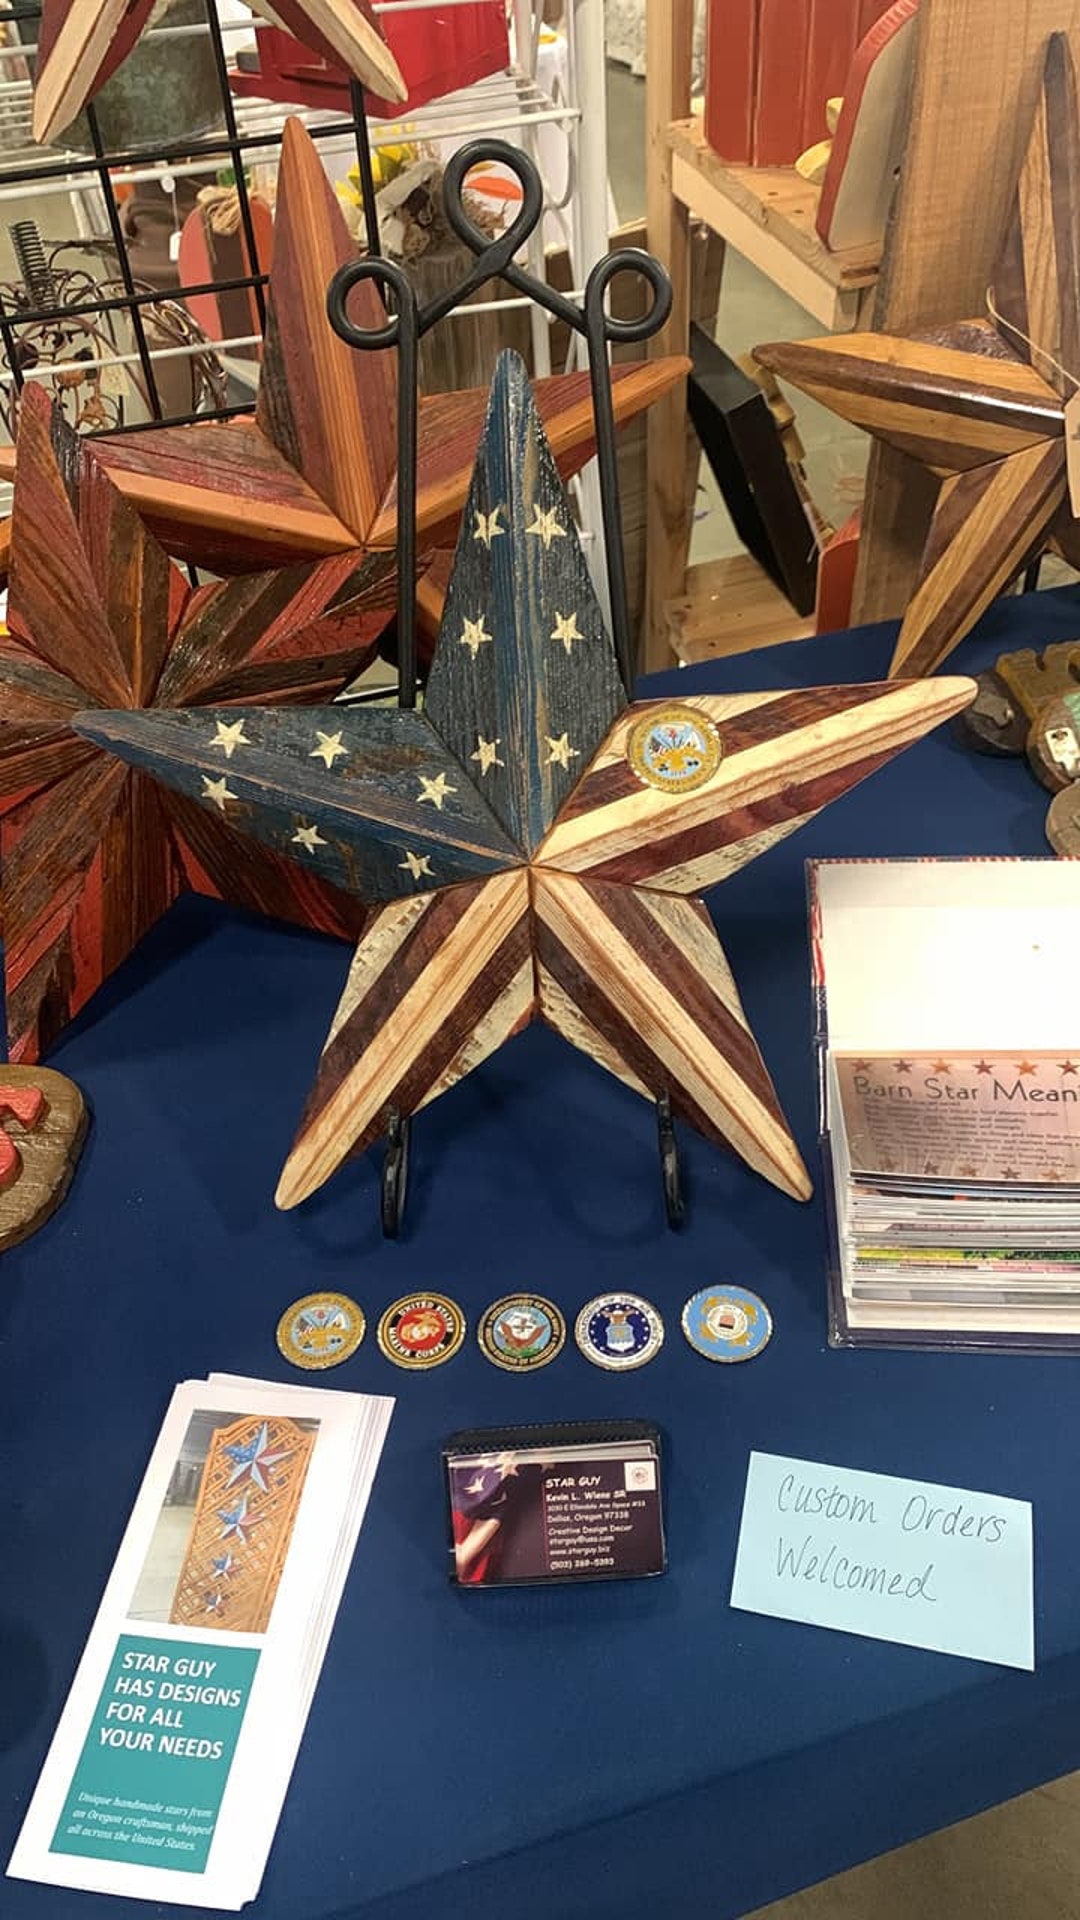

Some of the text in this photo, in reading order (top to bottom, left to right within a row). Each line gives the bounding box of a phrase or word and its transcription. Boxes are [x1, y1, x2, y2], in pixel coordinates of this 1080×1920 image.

[853, 1076, 1080, 1103] Barn Star Mean
[545, 1475, 601, 1489] STAR GUY
[546, 1493, 569, 1503] Kevin
[778, 1474, 1007, 1542] Custom Orders
[548, 1527, 581, 1536] Creative
[582, 1525, 608, 1535] Design
[574, 1513, 602, 1523] Oregon
[776, 1535, 937, 1602] Welcomed
[122, 1652, 217, 1679] STAR GUY
[114, 1676, 242, 1708] HAS DESIGNS
[105, 1701, 184, 1728] FOR ALL
[99, 1727, 224, 1759] YOUR NEEDS
[78, 1791, 214, 1820] Unique handmade stars from
[66, 1824, 81, 1835] all
[81, 1827, 113, 1840] across
[114, 1831, 131, 1842] the
[131, 1832, 165, 1847] United
[72, 1809, 86, 1819] an
[87, 1809, 122, 1826] Oregon
[175, 1821, 215, 1837] shipped
